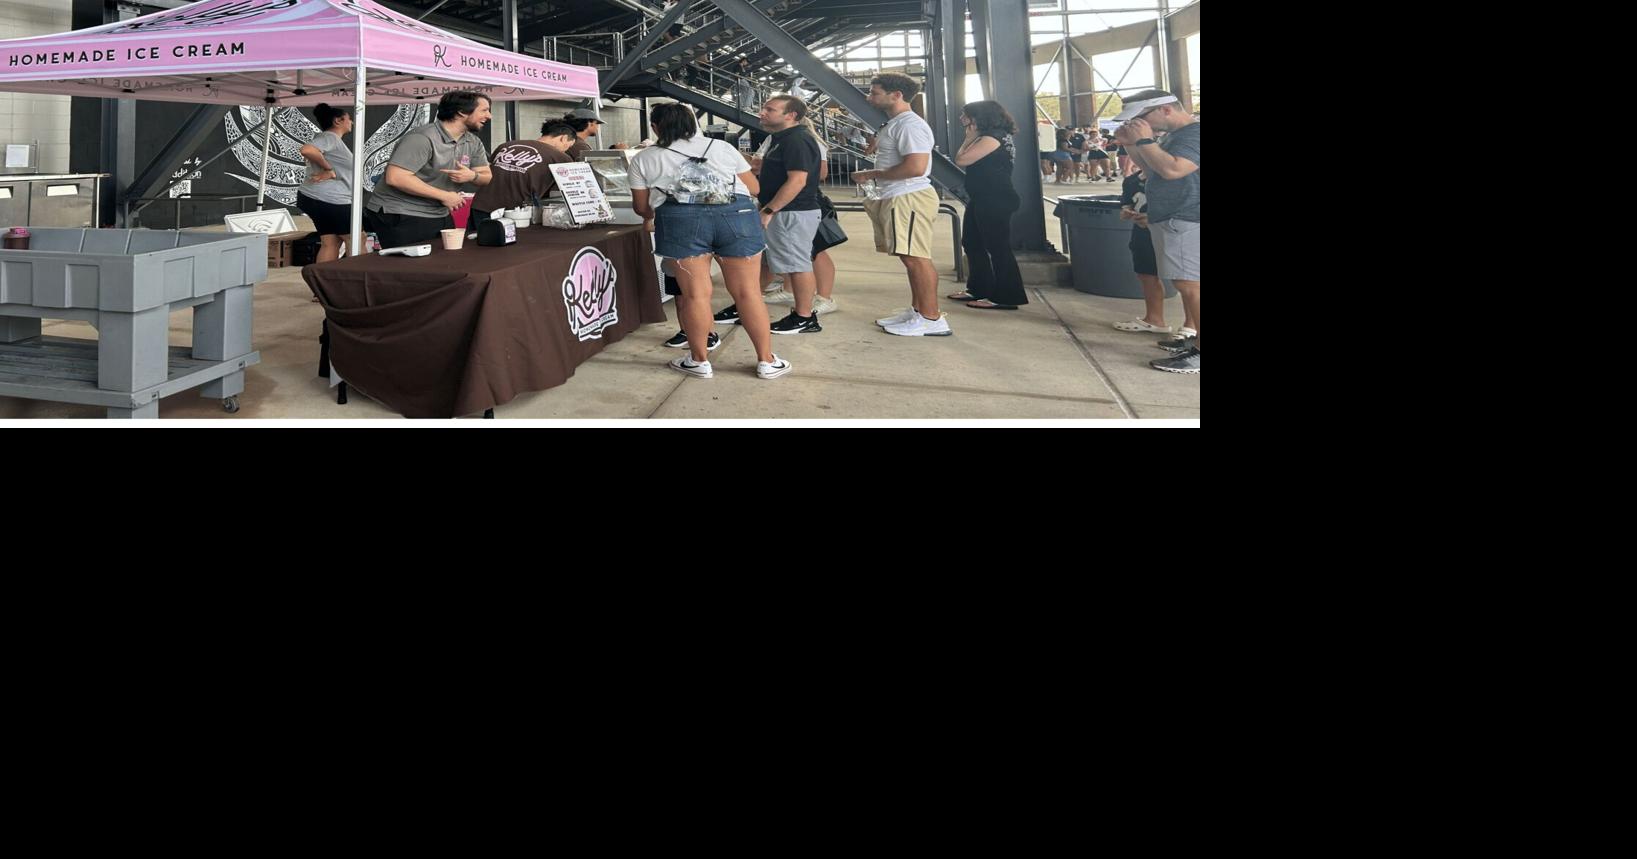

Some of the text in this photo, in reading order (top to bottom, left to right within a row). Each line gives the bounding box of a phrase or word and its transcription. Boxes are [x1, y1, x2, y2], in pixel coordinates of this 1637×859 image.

[9, 42, 245, 67] HOMEMADE ICE CREAM
[460, 55, 520, 75] HOMEMADE
[523, 66, 538, 78] ICE
[541, 70, 568, 83] CREAM
[492, 147, 543, 166] Kelly's
[564, 261, 615, 329] Kelly's
